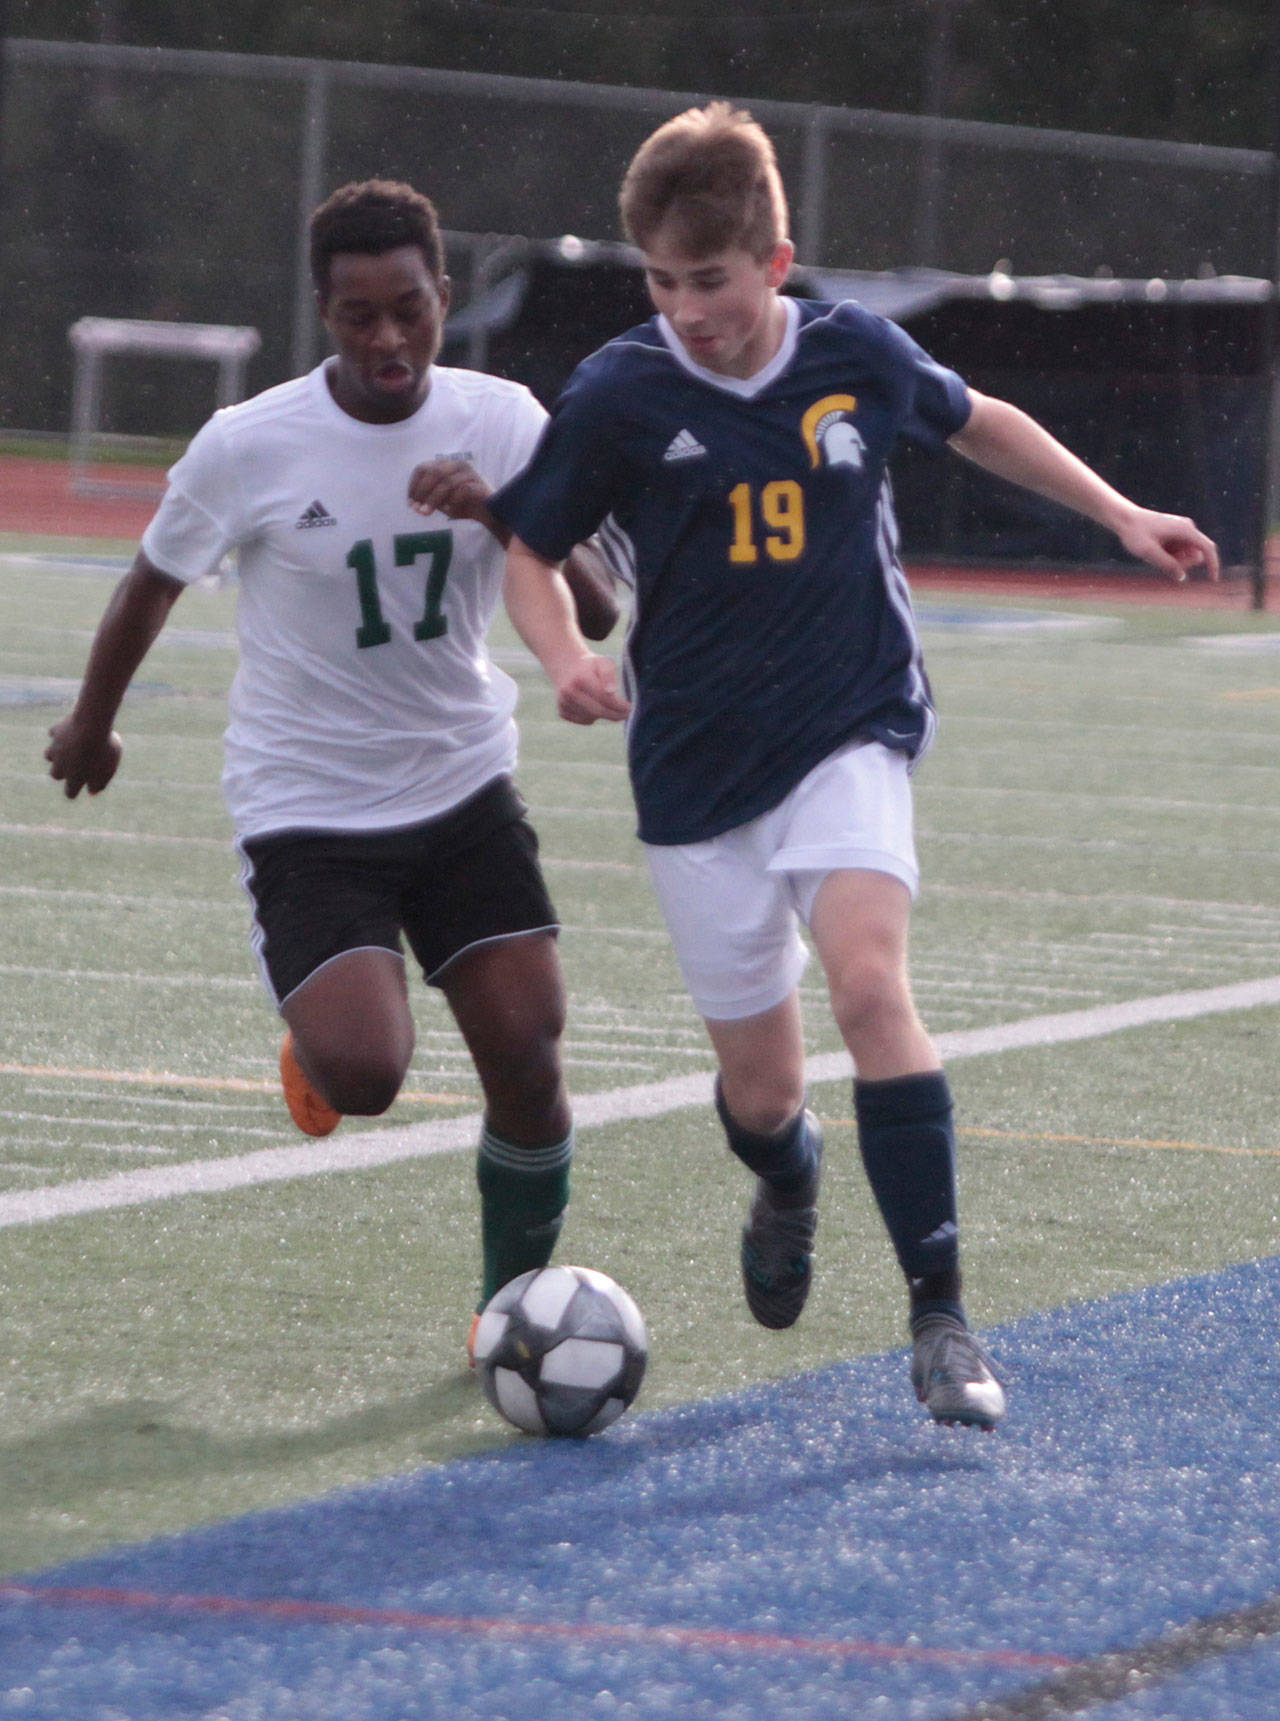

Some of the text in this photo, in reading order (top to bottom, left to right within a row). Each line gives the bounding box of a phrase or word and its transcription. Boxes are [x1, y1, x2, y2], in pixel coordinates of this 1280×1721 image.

[295, 517, 338, 530] adidas
[728, 479, 804, 563] 19
[346, 528, 453, 649] 17
